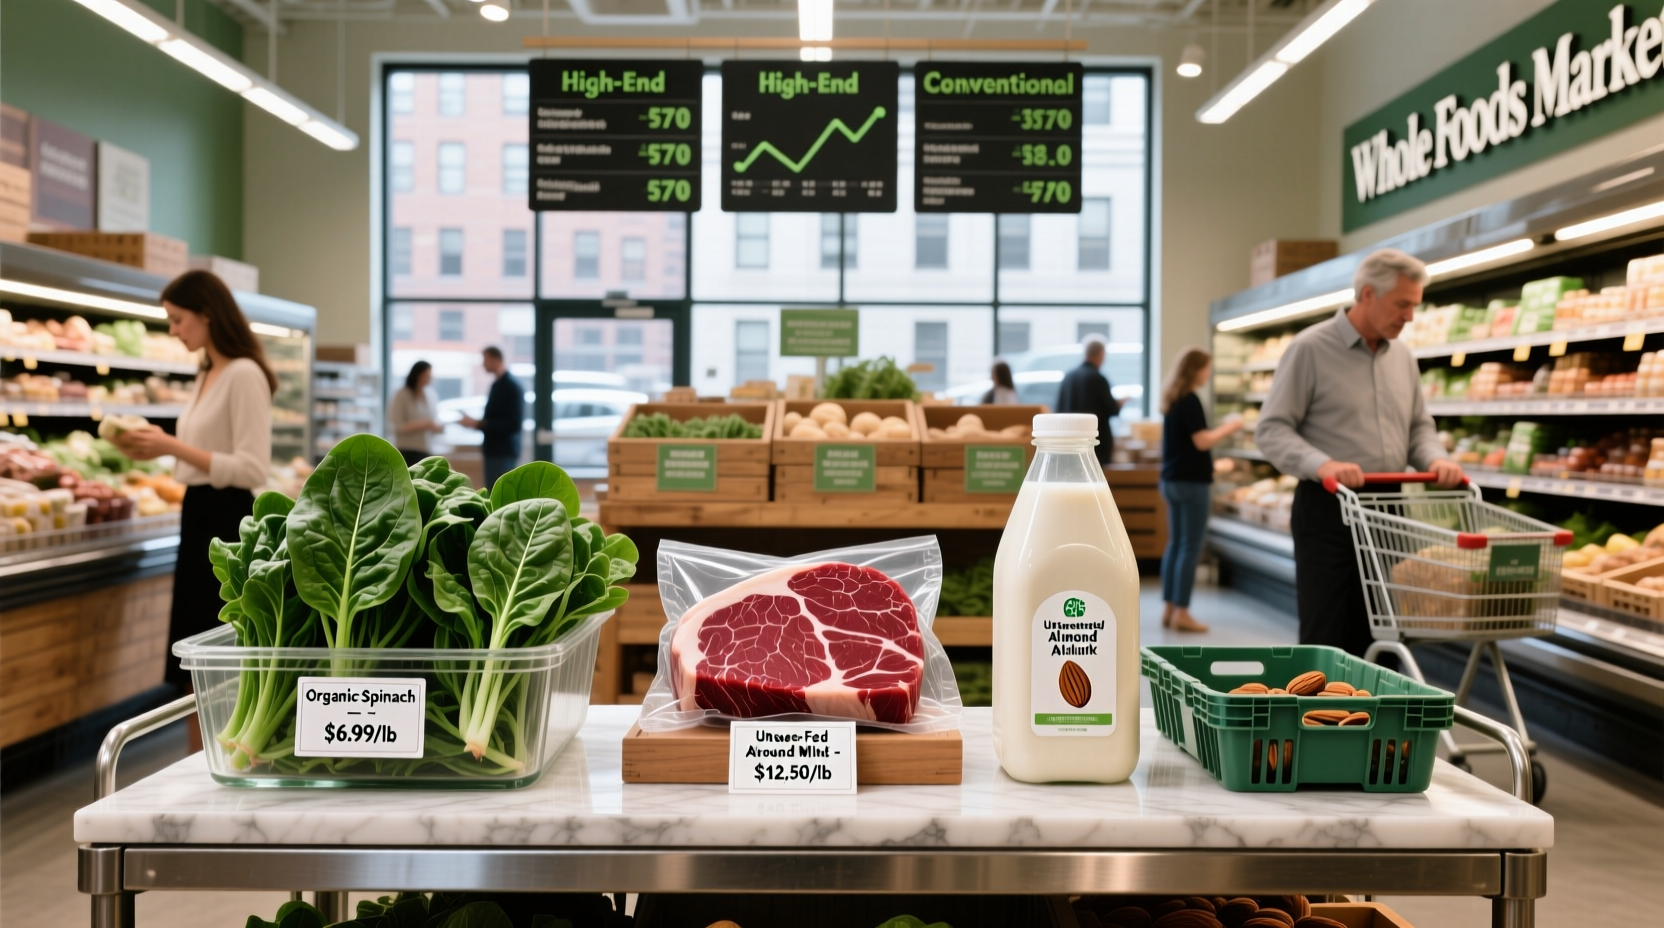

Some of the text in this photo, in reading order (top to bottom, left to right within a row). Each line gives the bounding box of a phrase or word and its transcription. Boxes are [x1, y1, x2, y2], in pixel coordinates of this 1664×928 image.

[561, 70, 665, 99] High-End
[759, 71, 859, 99] High-End
[923, 71, 1074, 95] Conventional
[1351, 112, 1433, 203] Whole
[1433, 60, 1527, 170] Foods
[306, 688, 415, 707] Organic Spinach
[324, 721, 397, 744] $6.99/lb
